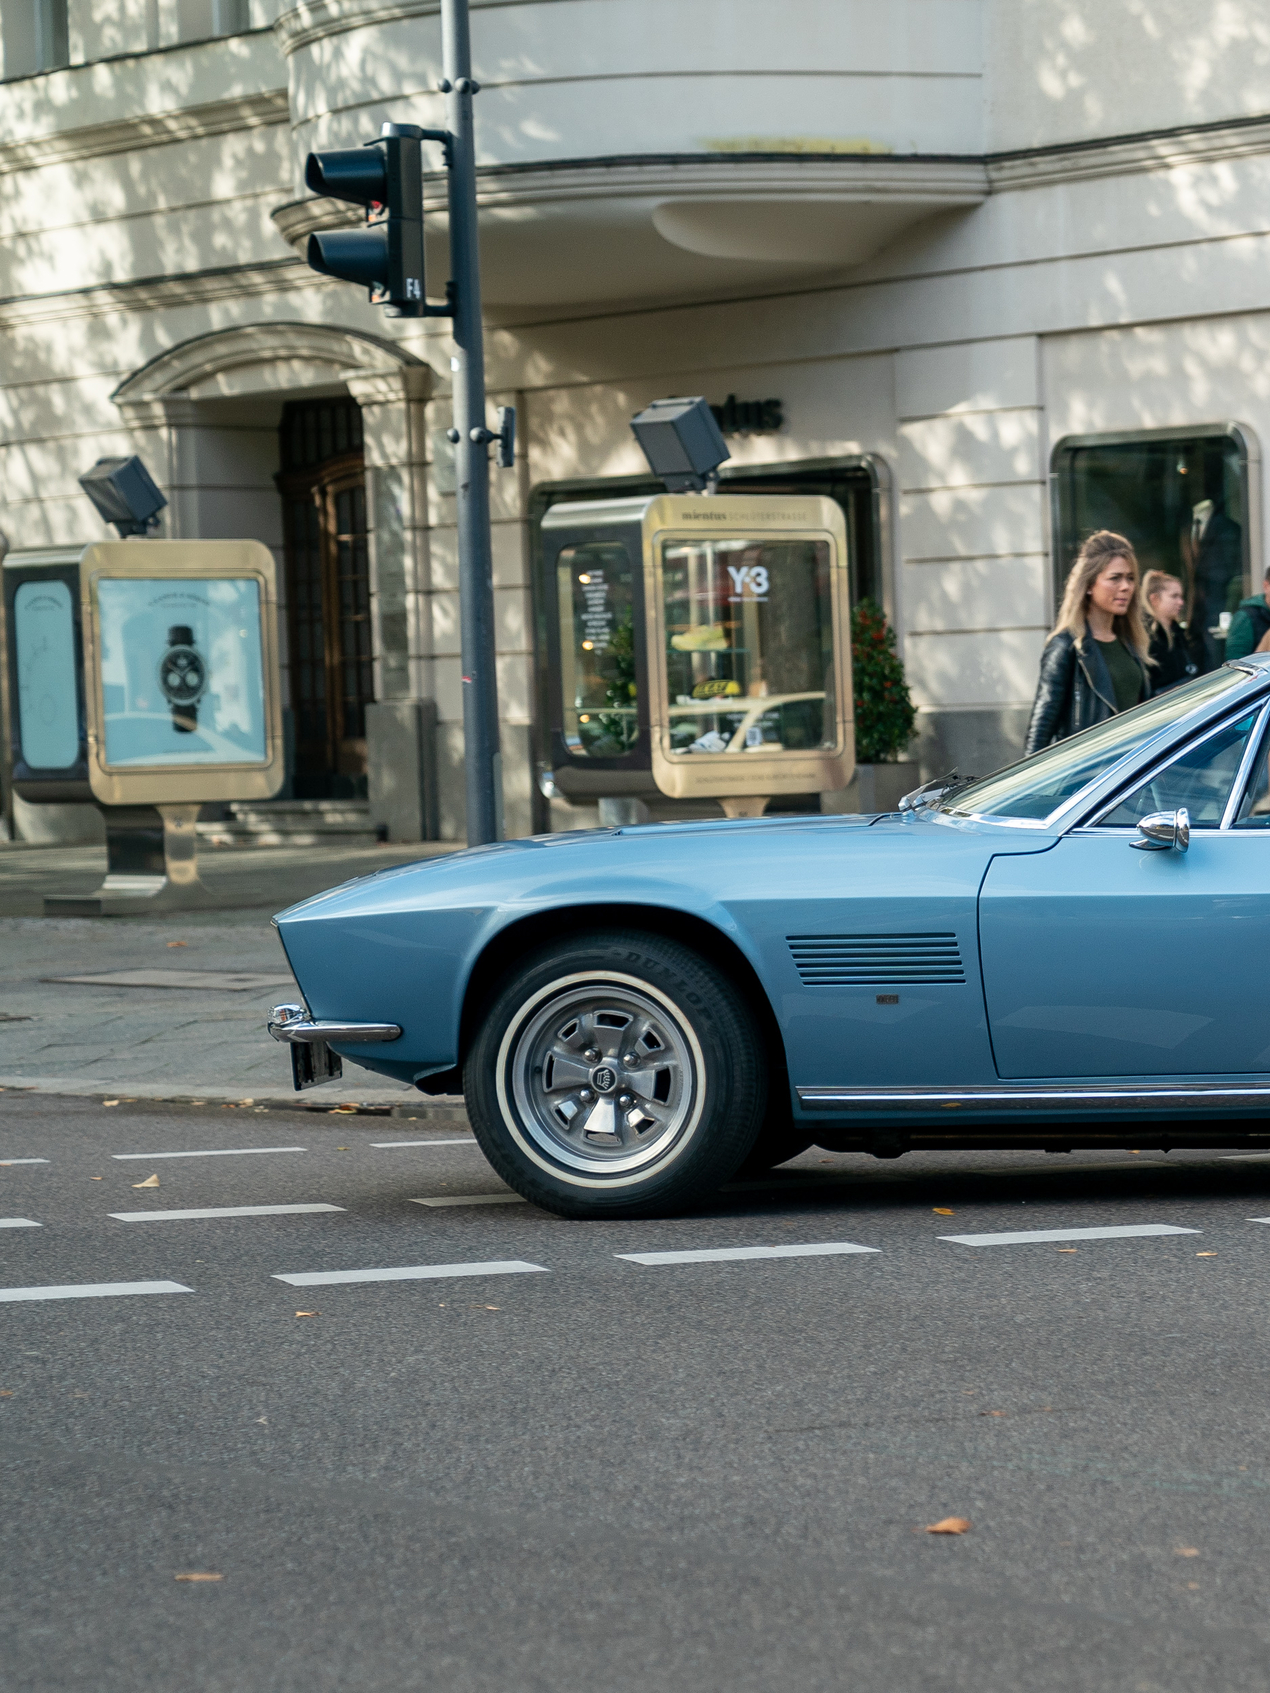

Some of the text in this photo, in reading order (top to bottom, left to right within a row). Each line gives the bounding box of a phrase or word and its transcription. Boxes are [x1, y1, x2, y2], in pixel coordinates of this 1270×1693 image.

[405, 277, 421, 299] F4
[682, 509, 727, 521] mientus
[624, 951, 714, 1021] DUNLOP
